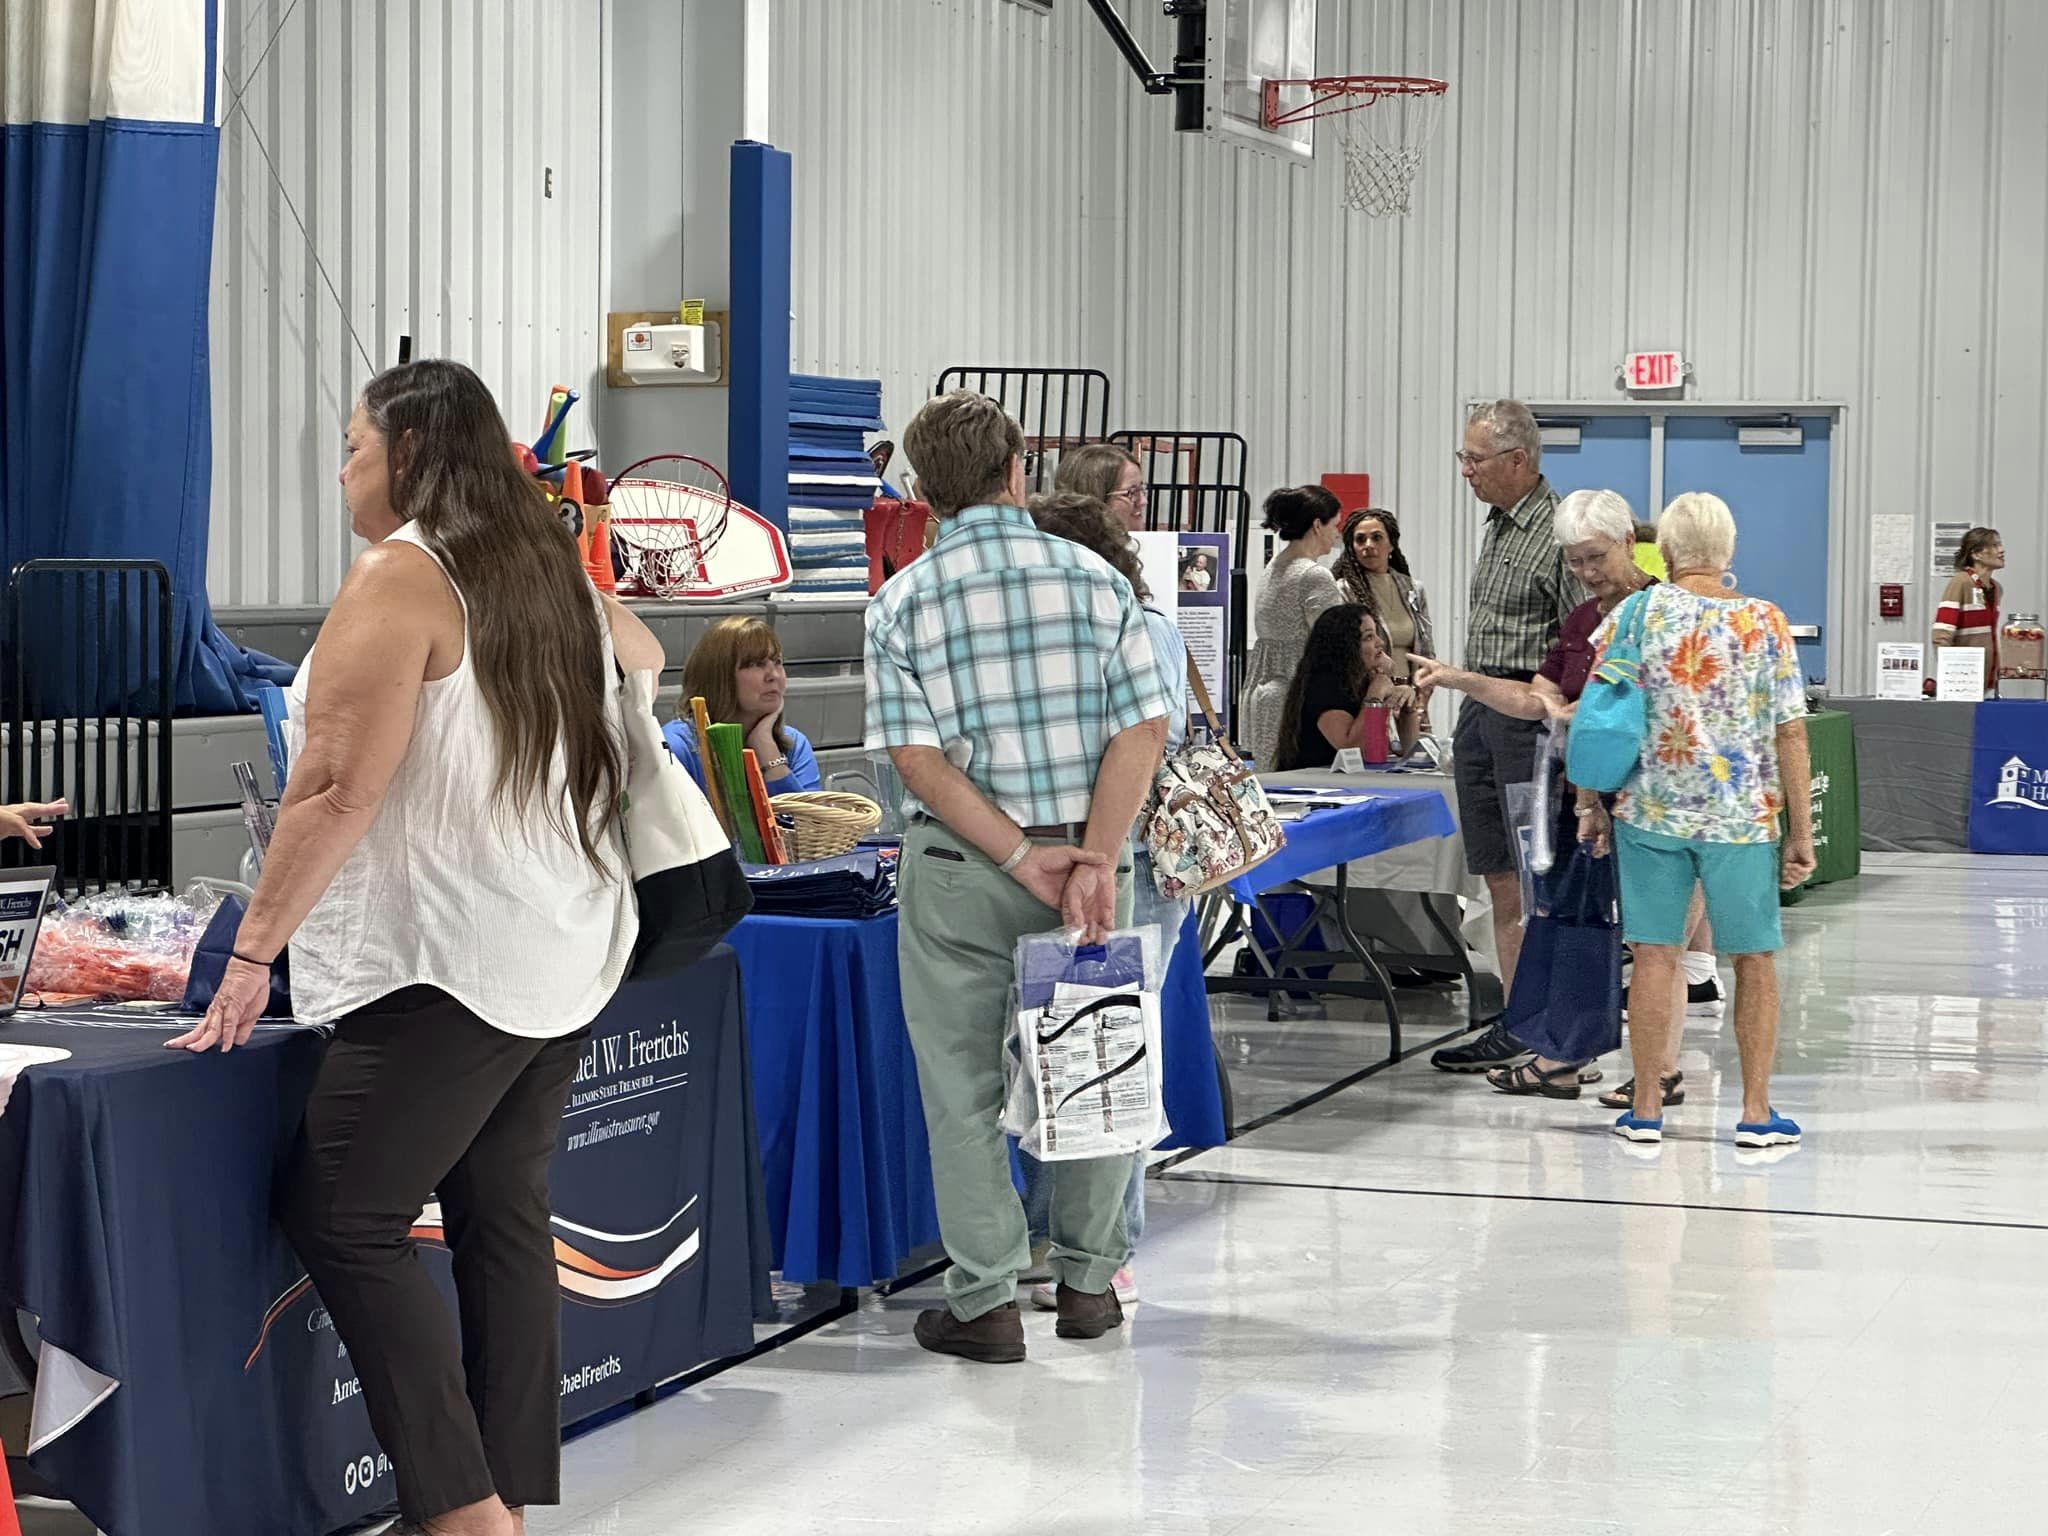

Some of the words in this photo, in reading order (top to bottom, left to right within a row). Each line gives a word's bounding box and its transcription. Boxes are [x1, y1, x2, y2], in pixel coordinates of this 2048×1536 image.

[1635, 354, 1674, 385] EXIT
[572, 1040, 598, 1083] ael
[602, 1035, 623, 1075] W.
[628, 1020, 689, 1069] Frerichs
[331, 1377, 362, 1405] Ame
